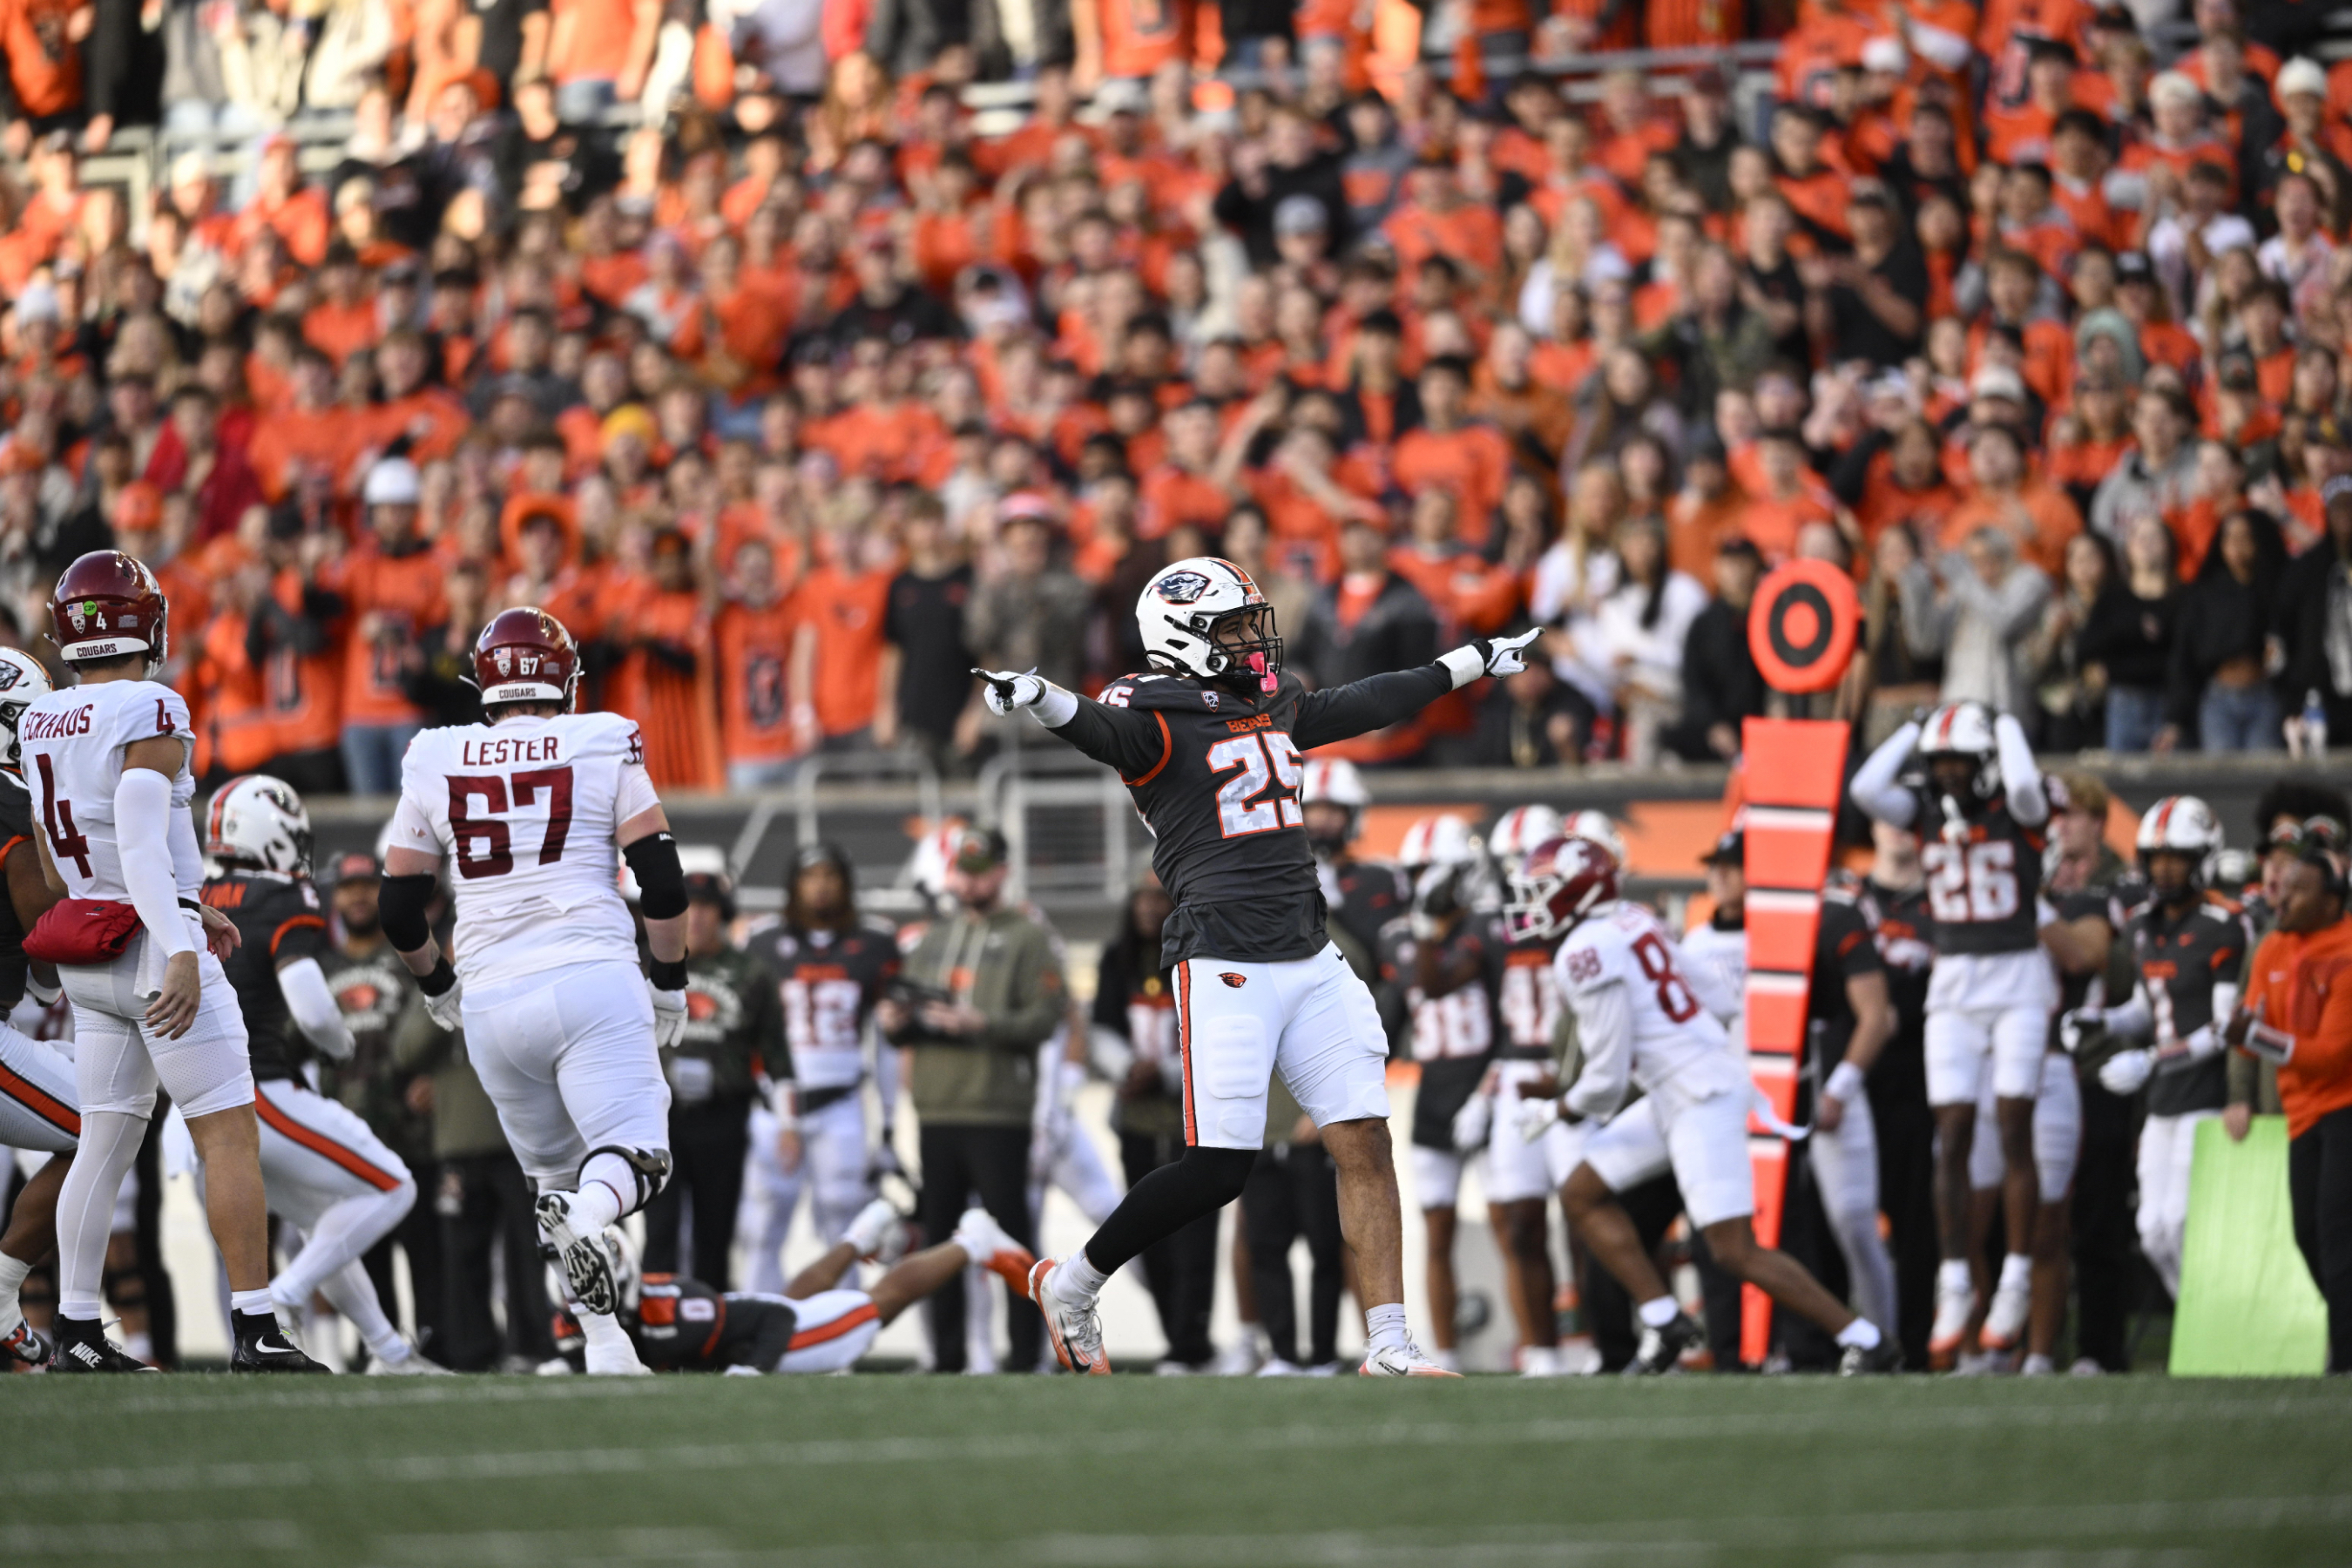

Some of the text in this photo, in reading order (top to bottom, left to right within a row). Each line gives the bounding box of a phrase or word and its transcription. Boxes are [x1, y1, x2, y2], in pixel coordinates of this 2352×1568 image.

[96, 612, 107, 630] 4
[76, 643, 118, 658] COUGARS
[519, 657, 539, 676] 67
[498, 687, 537, 700] COUGARS
[24, 703, 94, 741] ECKHAUS
[155, 698, 177, 735] 4
[463, 736, 558, 767] LESTER
[1206, 731, 1305, 839] 25
[35, 753, 94, 880] 4
[444, 765, 574, 880] 67
[1921, 839, 2019, 923] 26
[69, 1342, 103, 1369] NIKE
